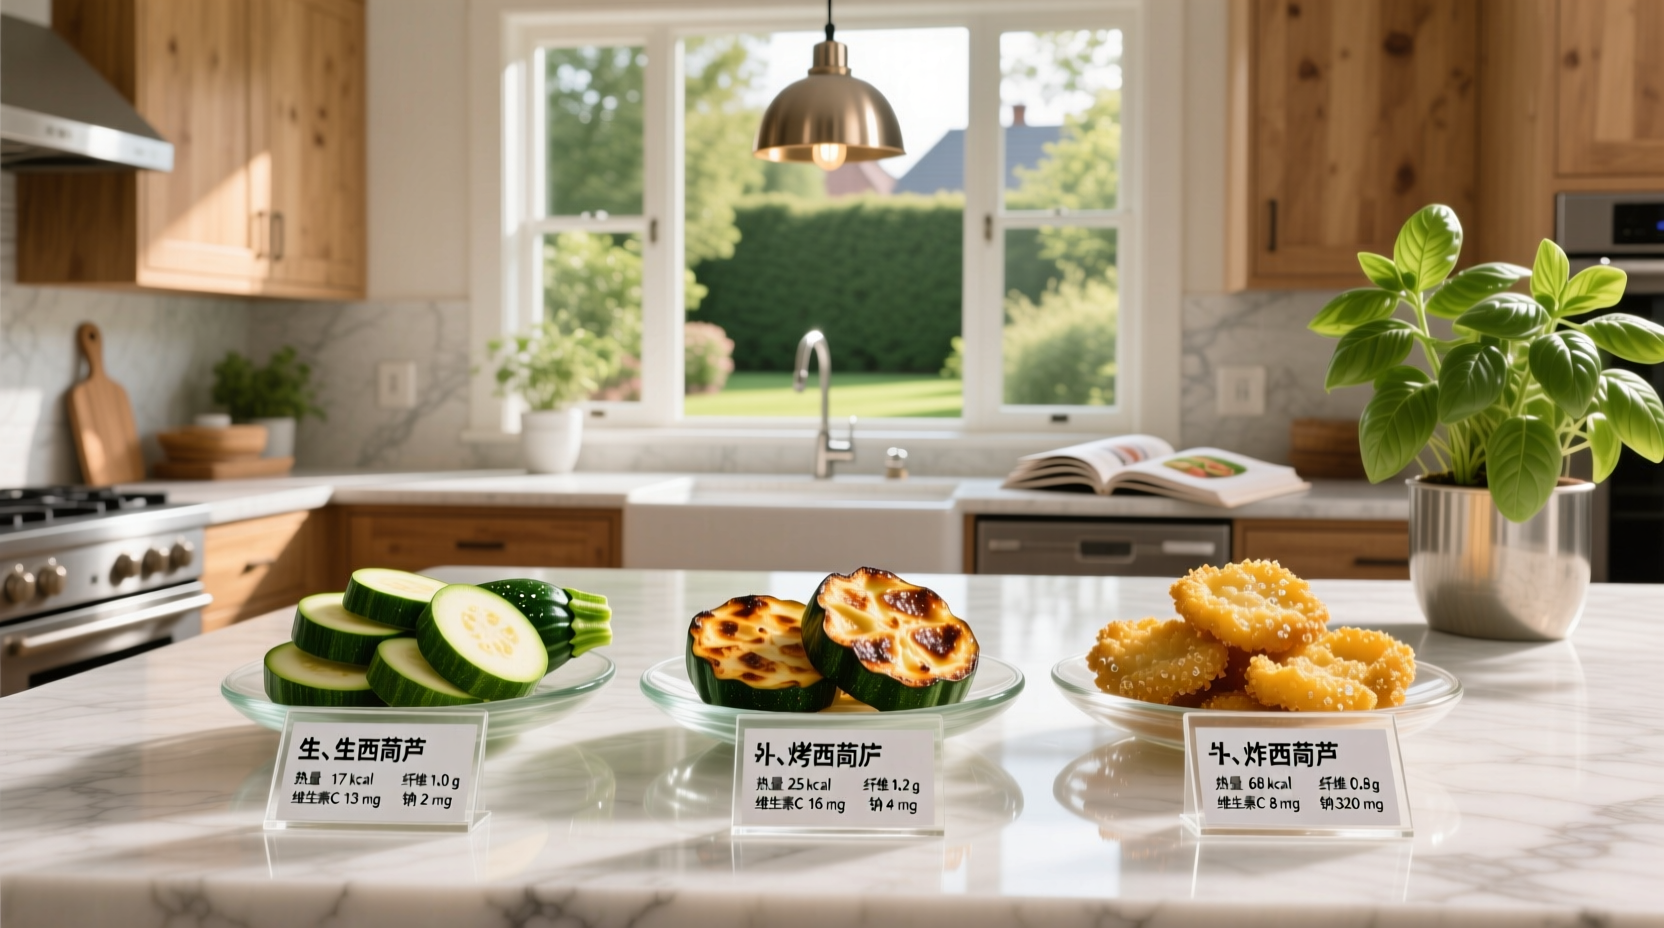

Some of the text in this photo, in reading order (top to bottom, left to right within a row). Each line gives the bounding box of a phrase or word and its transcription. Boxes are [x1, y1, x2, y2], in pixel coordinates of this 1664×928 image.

[332, 773, 347, 786] 17
[350, 772, 374, 786] kcal
[431, 773, 449, 787] 1.0
[452, 776, 460, 790] g
[787, 777, 804, 791] 25
[807, 777, 831, 791] kcal
[892, 778, 910, 791] 1.2
[912, 781, 920, 794] g
[1249, 776, 1264, 790] 68
[1267, 776, 1292, 790] kcal
[344, 792, 358, 805] 13
[362, 795, 381, 808] mg
[420, 793, 428, 806] 2
[432, 796, 452, 809] mg
[808, 797, 823, 810] 16
[826, 800, 845, 814] mg
[885, 798, 894, 811] 4
[898, 801, 917, 814] mg
[1269, 797, 1277, 810] 8
[1280, 799, 1300, 812] mg
[1363, 800, 1383, 812] mg
